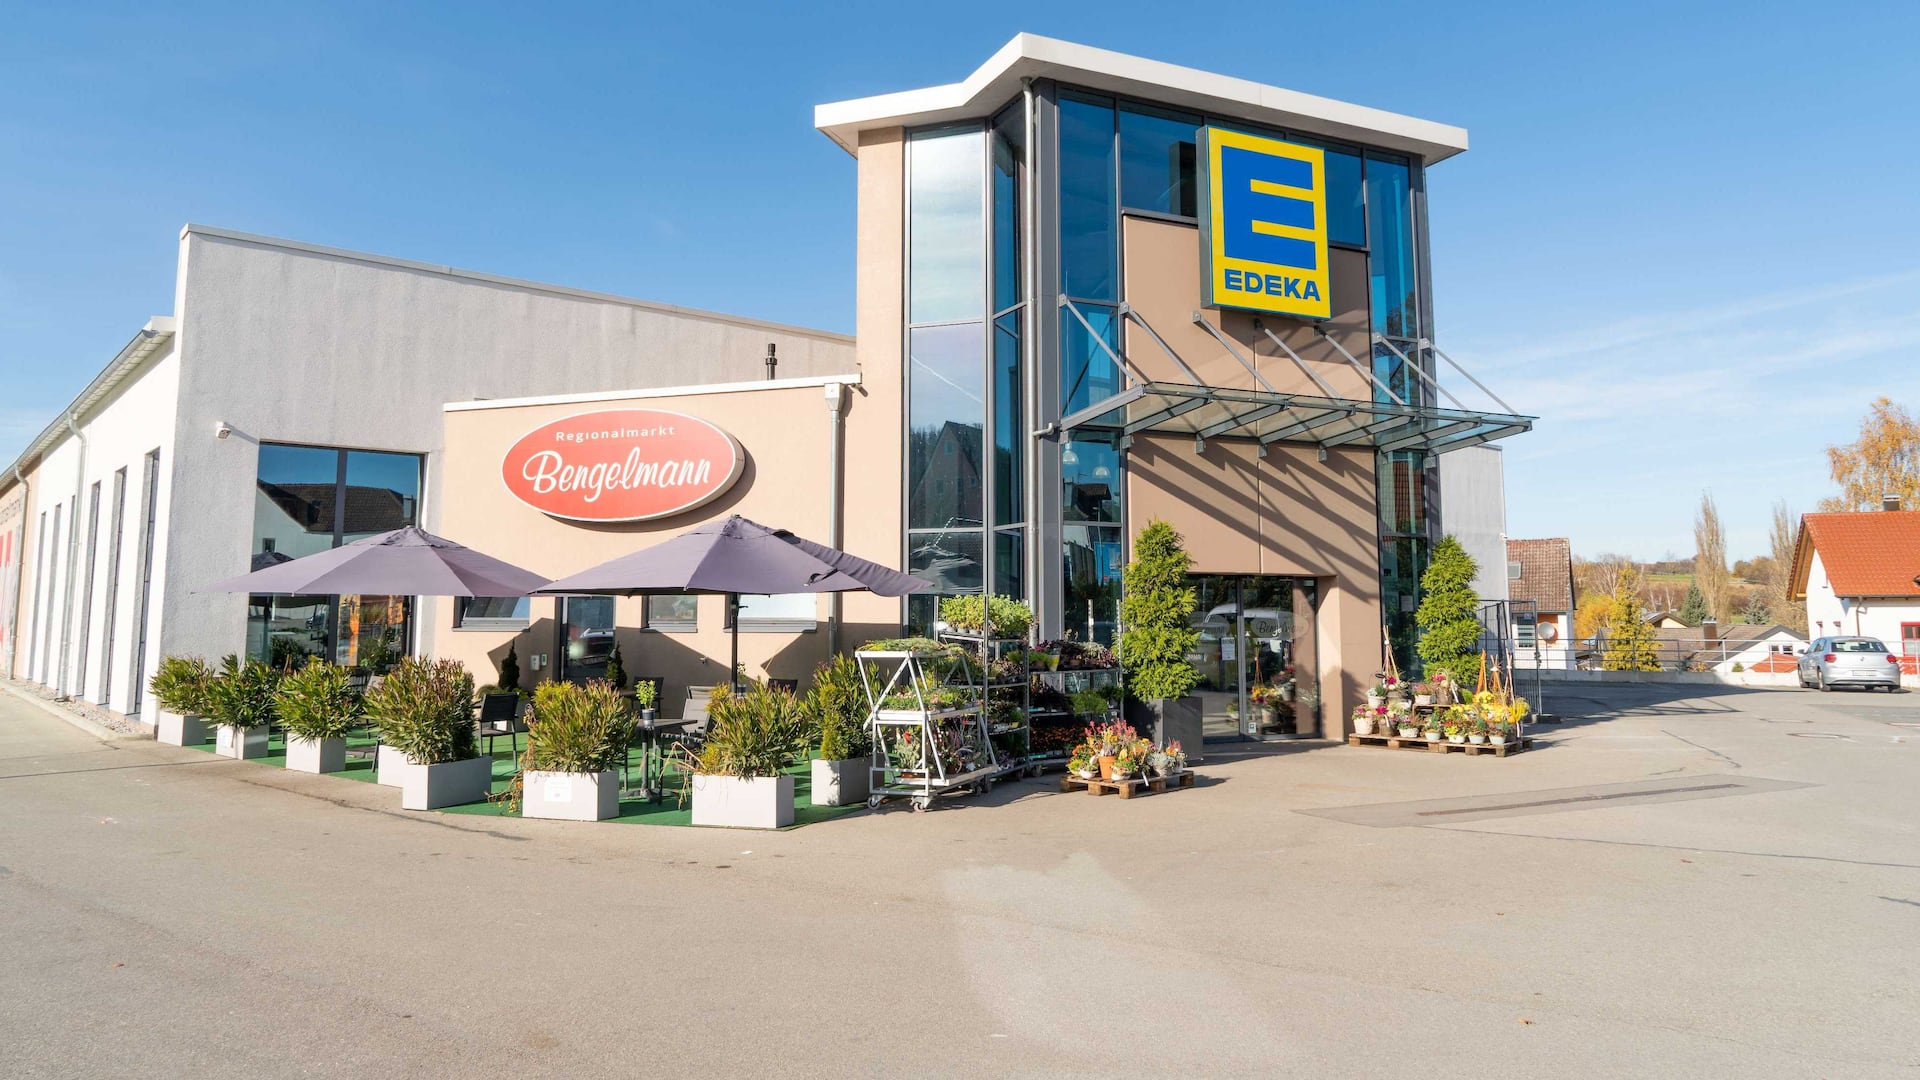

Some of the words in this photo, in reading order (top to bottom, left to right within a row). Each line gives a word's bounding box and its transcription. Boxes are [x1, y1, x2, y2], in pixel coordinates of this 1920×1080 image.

[1221, 145, 1317, 271] E
[1224, 268, 1321, 302] EDEKA
[555, 426, 676, 443] Regionalmarkt
[522, 446, 711, 503] Bengelmann
